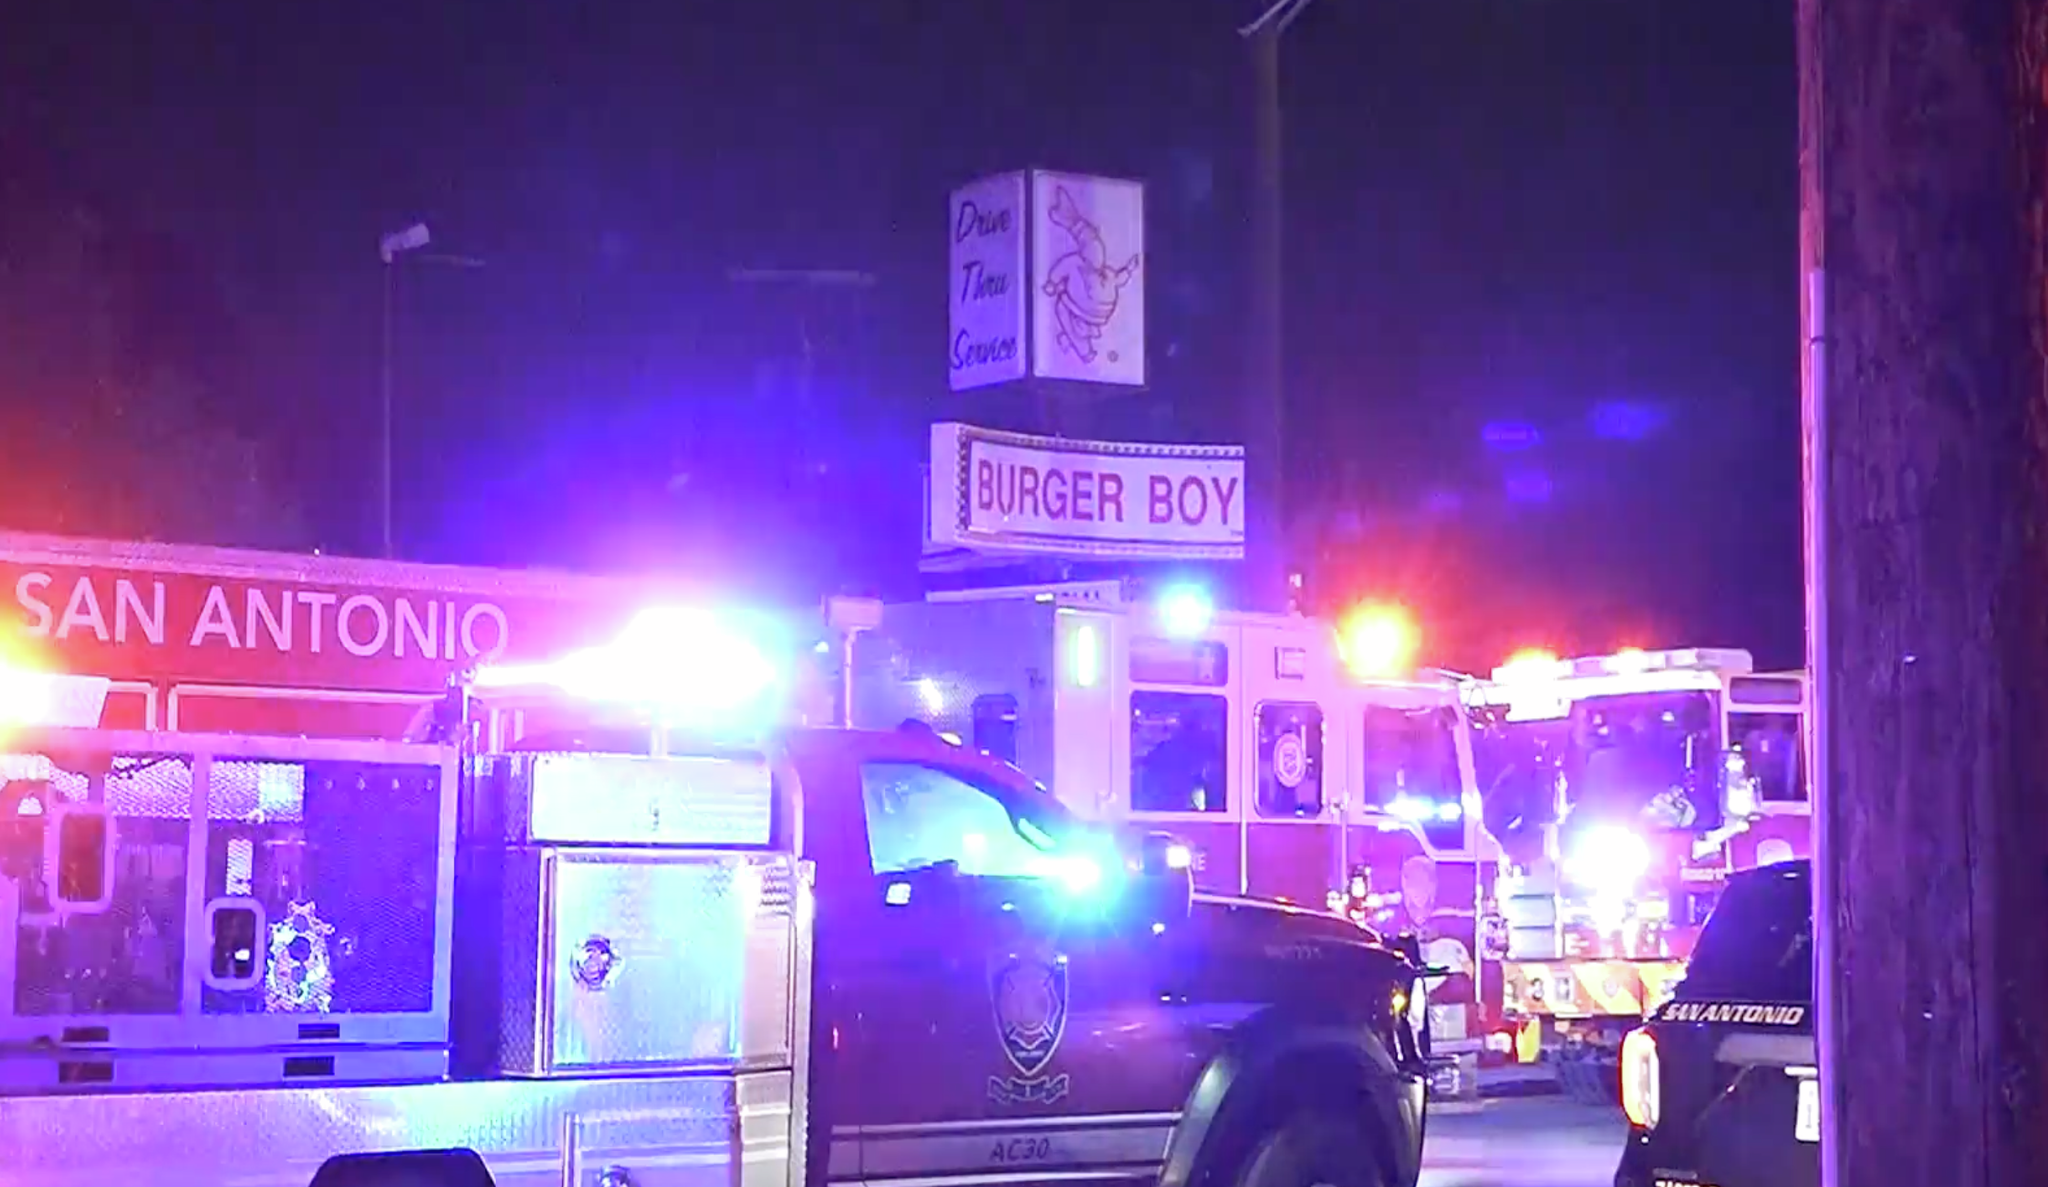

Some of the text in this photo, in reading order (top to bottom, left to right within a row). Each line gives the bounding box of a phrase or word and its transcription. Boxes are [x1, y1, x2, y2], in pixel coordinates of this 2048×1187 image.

[956, 199, 1011, 243] Drive
[962, 259, 1009, 304] Thru
[951, 326, 1018, 370] Service
[978, 458, 1239, 526] BURGER BOY
[15, 571, 509, 661] SAN ANTONIO
[990, 1137, 1050, 1163] AC30
